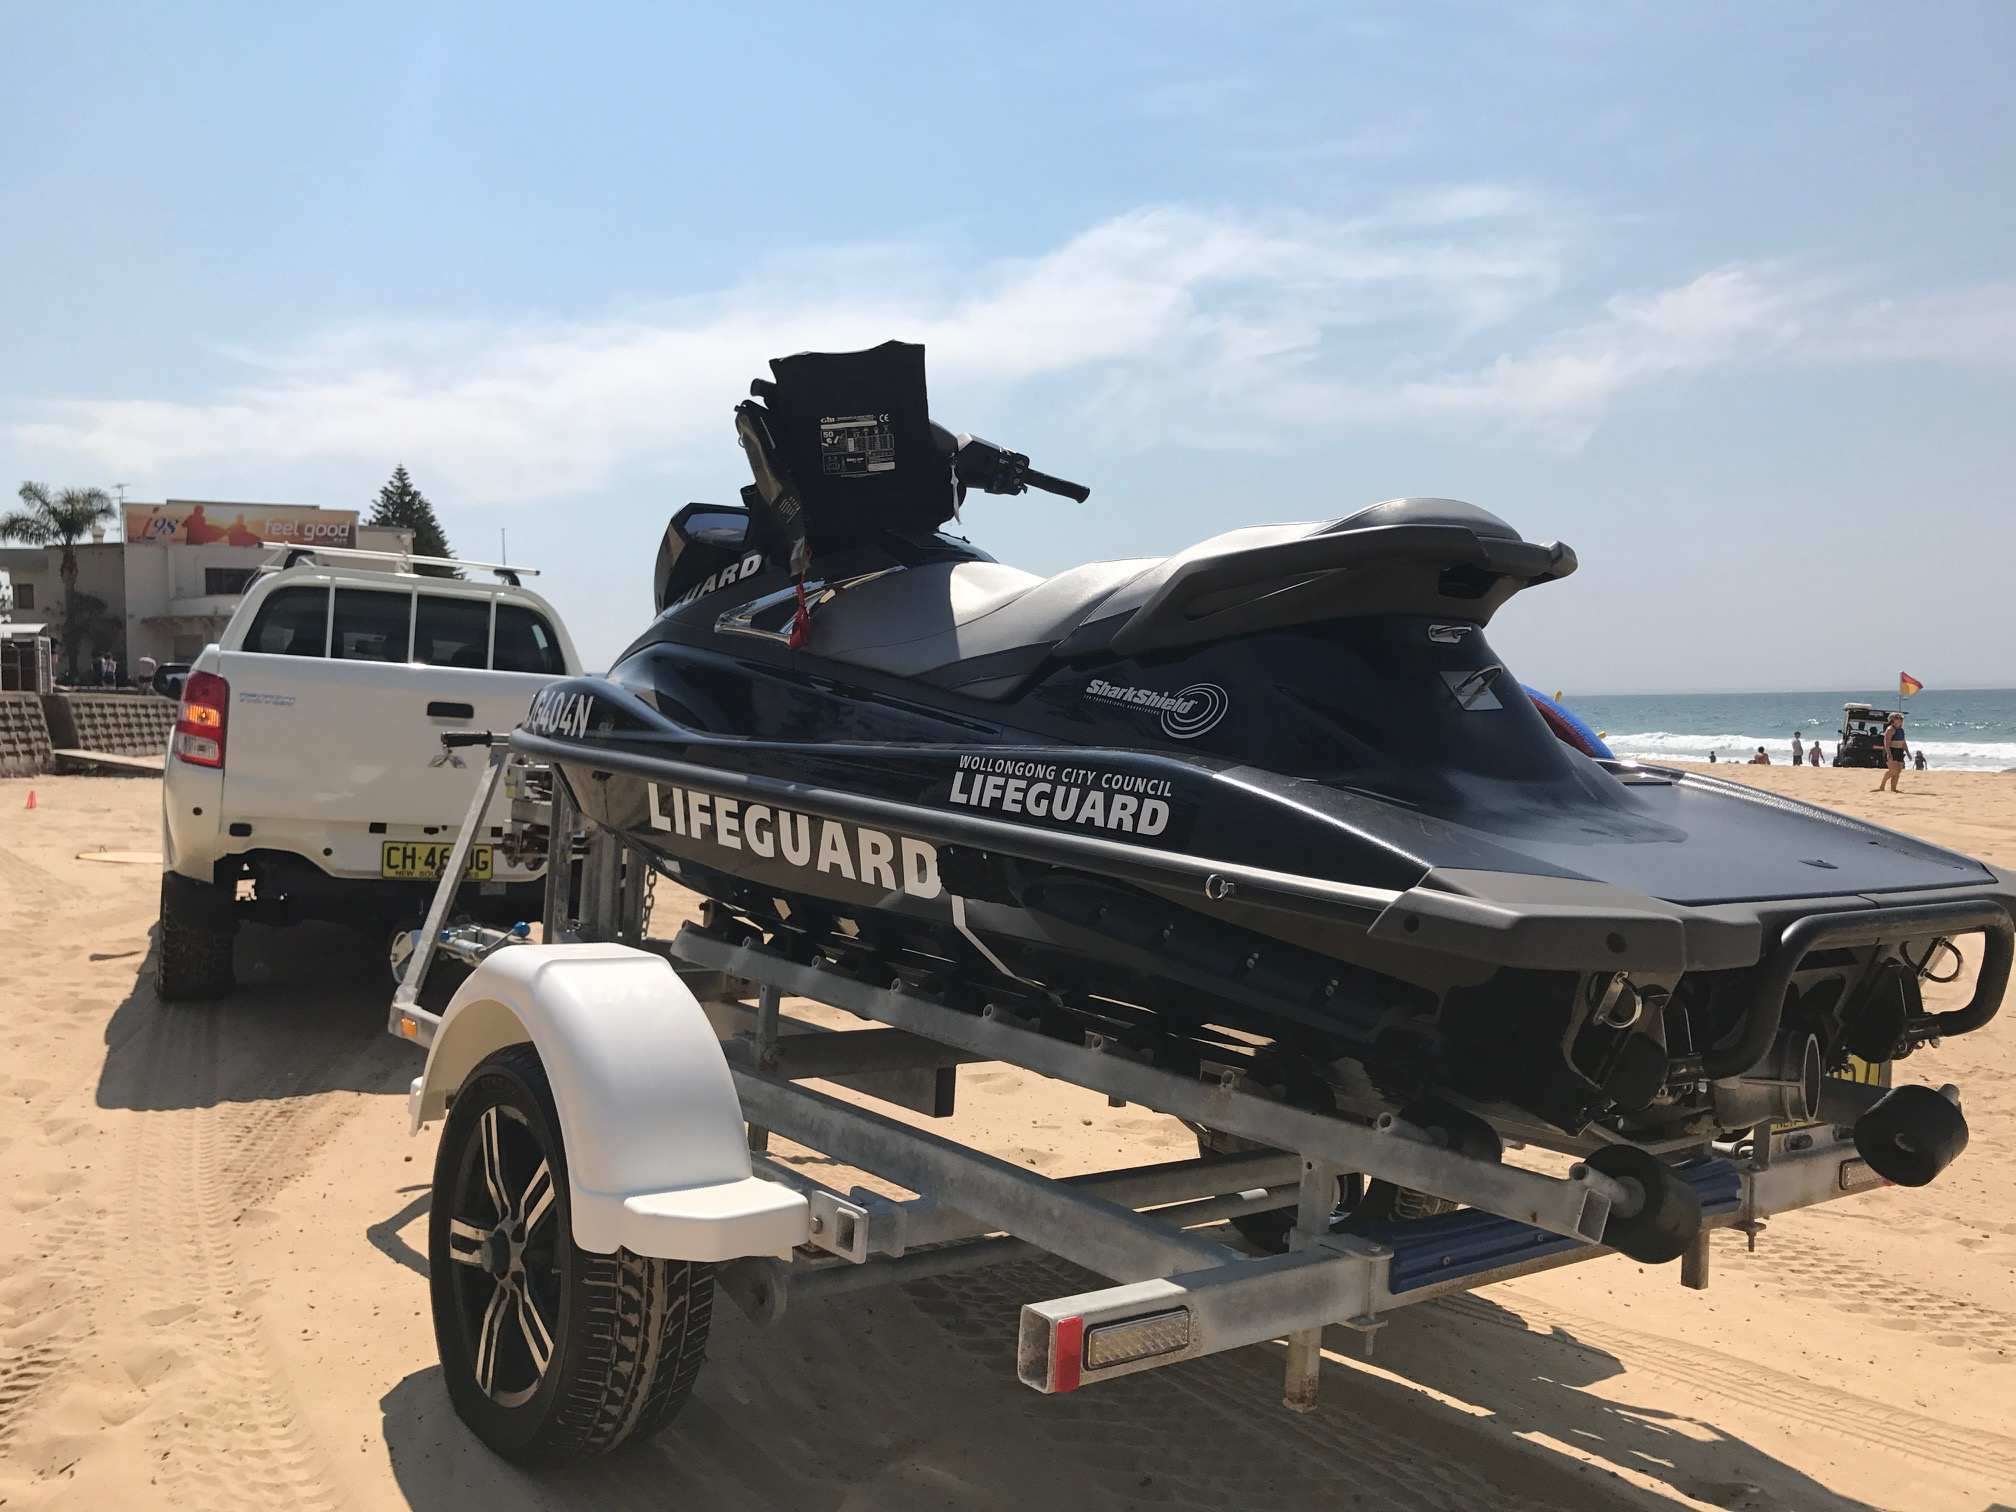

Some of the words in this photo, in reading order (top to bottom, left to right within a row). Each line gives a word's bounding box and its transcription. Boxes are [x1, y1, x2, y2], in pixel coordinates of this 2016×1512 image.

[264, 519, 299, 536] feel
[304, 520, 350, 541] good
[1085, 679, 1194, 714] SharkShield
[959, 754, 1057, 780] WOLLONGONG
[1061, 767, 1097, 786] CITY
[1101, 773, 1172, 797] COUNCIL
[949, 771, 1170, 836] LIFEGUARD
[648, 782, 943, 899] LIFEGUARD
